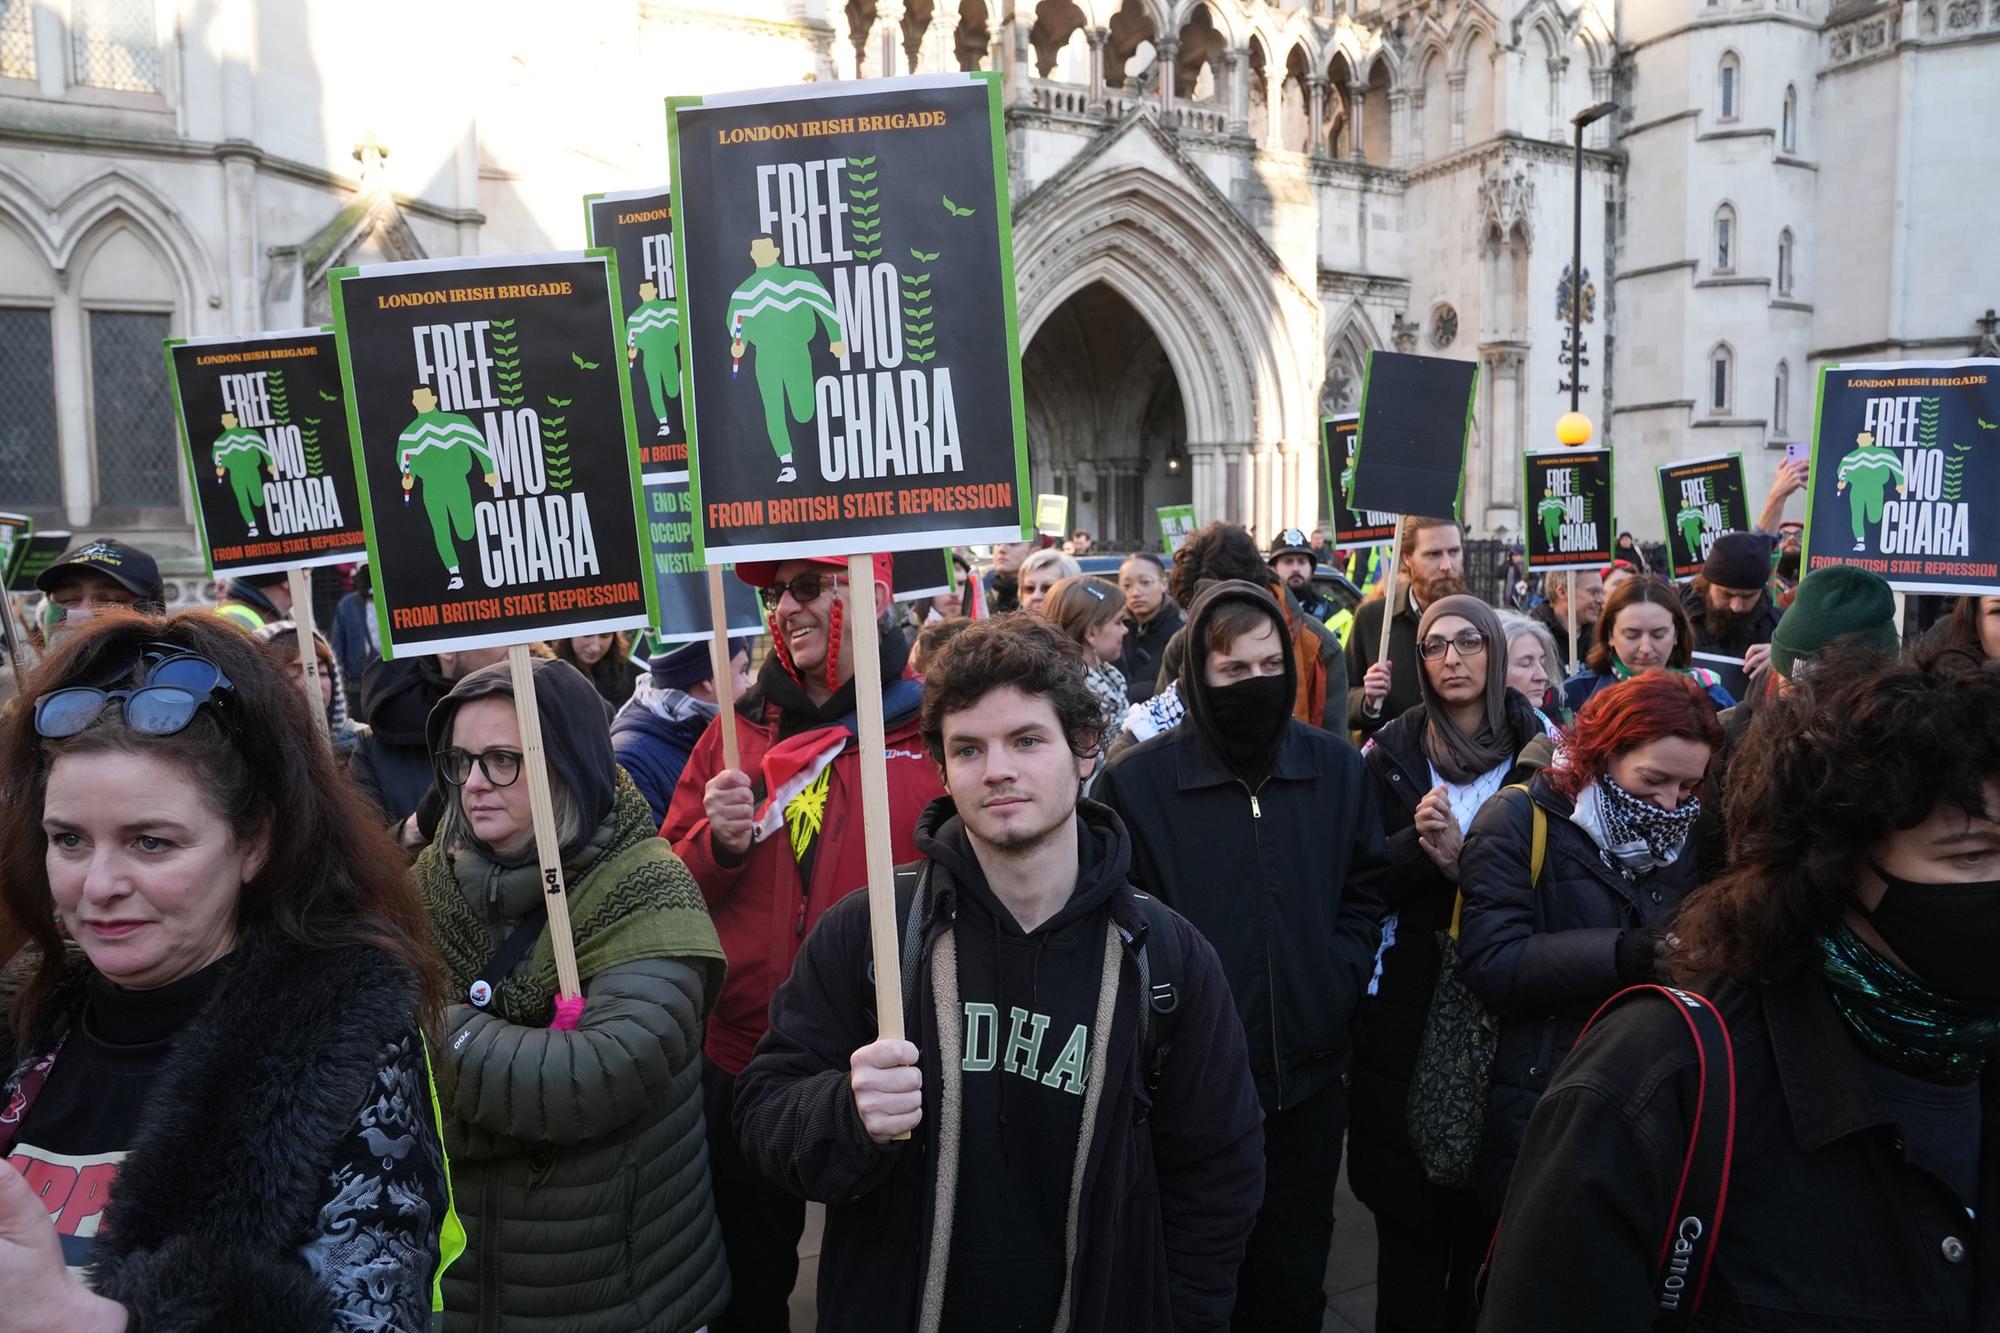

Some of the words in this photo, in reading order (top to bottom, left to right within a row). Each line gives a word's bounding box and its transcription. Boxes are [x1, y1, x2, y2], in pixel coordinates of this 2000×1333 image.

[719, 123, 799, 145] LONDON
[801, 117, 855, 138] IRISH
[858, 110, 946, 133] BRIGADE
[617, 208, 667, 225] LONDON
[756, 158, 853, 266] FREE
[642, 232, 677, 300] FR
[378, 291, 453, 309] LONDON
[450, 286, 497, 303] IRISH
[497, 282, 572, 299] BRIGADE
[833, 262, 903, 371] MO
[196, 353, 242, 365] LONDON
[243, 350, 269, 362] IRISH
[271, 346, 318, 360] BRIGADE
[412, 320, 500, 411] FREE
[219, 371, 276, 428] FREE
[1848, 378, 1895, 388] LONDON
[1897, 377, 1931, 386] IRISH
[1932, 375, 1988, 386] BRIGADE
[815, 367, 964, 482] CHARA
[1864, 396, 1922, 447] FREE
[264, 424, 307, 481] MO
[483, 408, 547, 498] MO
[652, 443, 689, 463] BRITIS
[1900, 449, 1944, 501] MO
[652, 492, 677, 513] END
[709, 501, 764, 529] FROM
[768, 495, 839, 525] BRITISH
[843, 490, 895, 519] STATE
[898, 482, 1012, 514] REPRESSION
[1546, 468, 1572, 496] FREE
[1681, 477, 1708, 507] FREE
[262, 475, 344, 537] CHARA
[1566, 495, 1584, 524] MO
[1702, 503, 1723, 533] MO
[1879, 500, 1969, 556] CHARA
[213, 546, 243, 562] FROM
[245, 541, 282, 558] BRITISH
[283, 537, 310, 553] STATE
[311, 530, 366, 549] REPRESSIO
[474, 492, 601, 588] CHARA
[1559, 522, 1598, 552] CHARA
[1890, 560, 1923, 574] STATE
[1925, 562, 1998, 577] REPRESSION
[393, 604, 440, 629] FROM
[441, 598, 501, 624] BRITISH
[503, 592, 547, 618] STATE
[548, 581, 639, 612] REPRESSION
[453, 1030, 471, 1050] 700
[962, 1002, 1093, 1096] DHA
[1660, 1216, 1703, 1310] Canon
